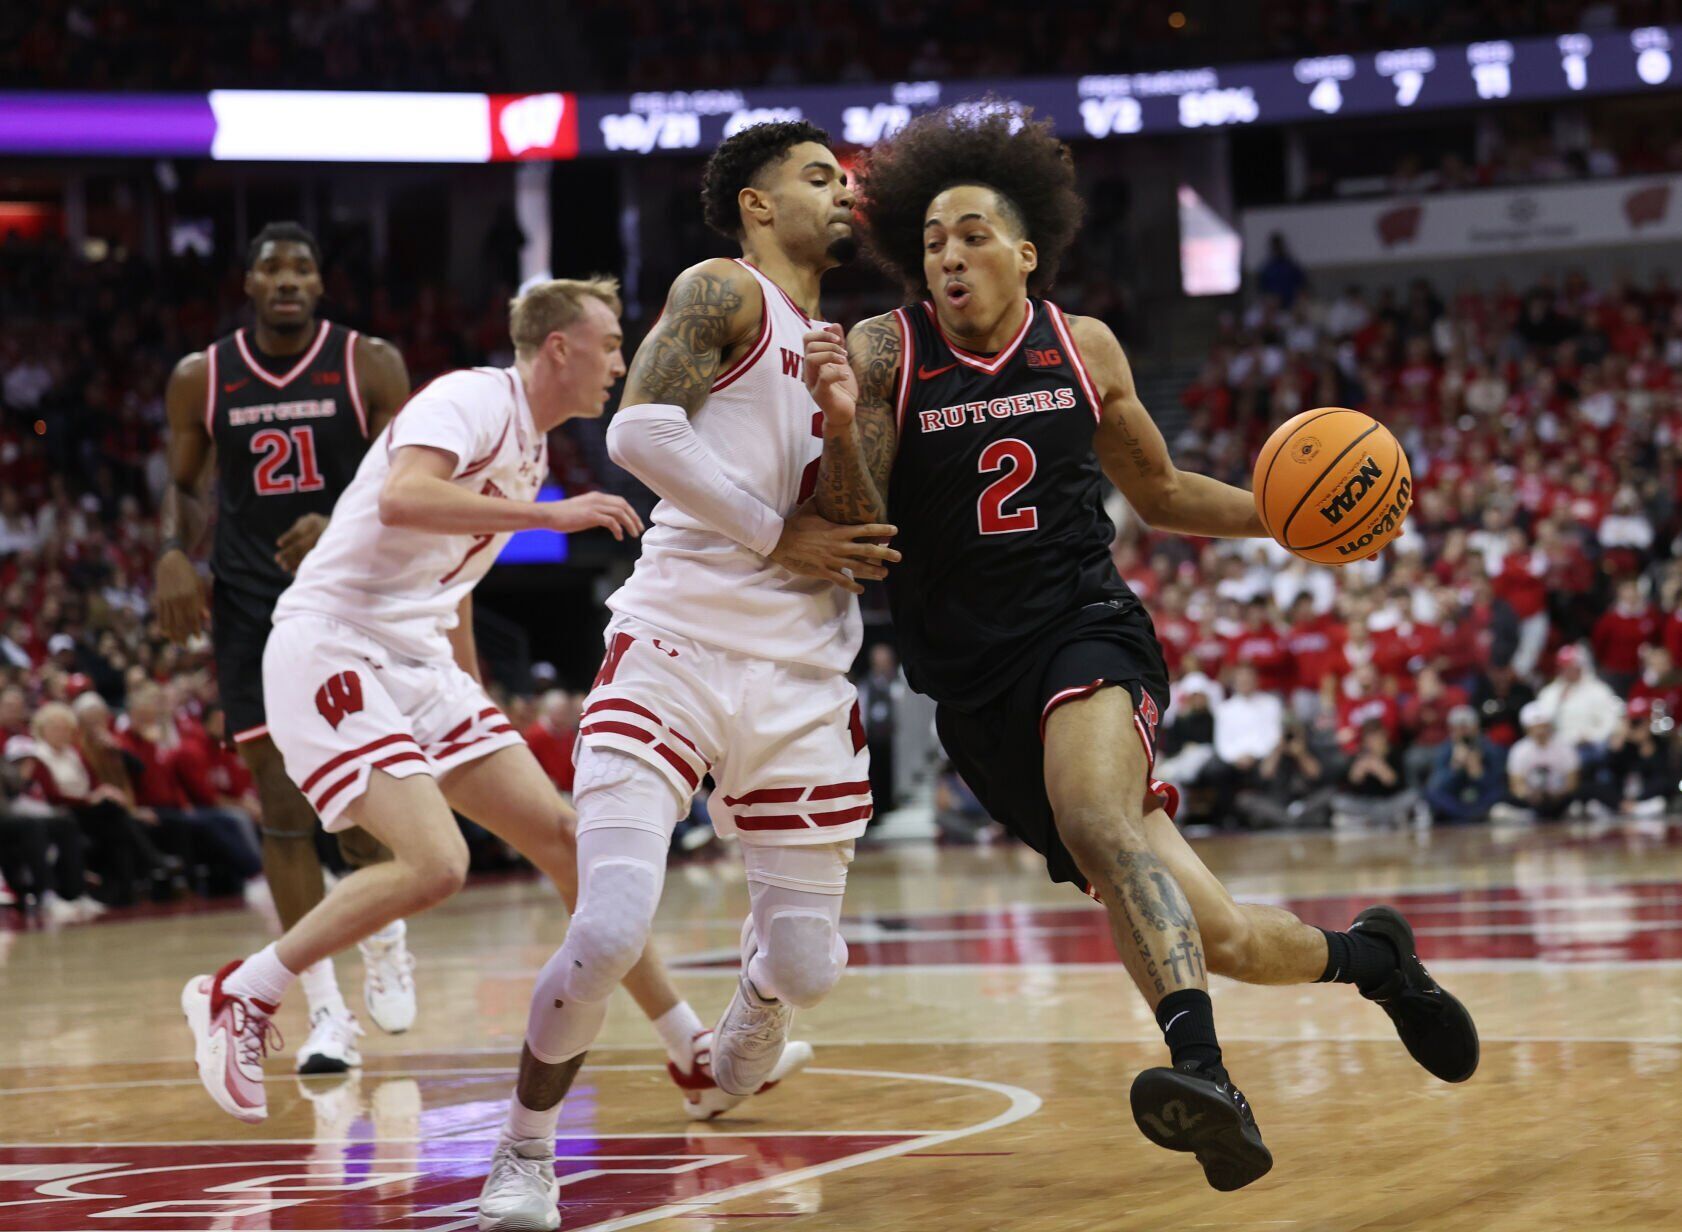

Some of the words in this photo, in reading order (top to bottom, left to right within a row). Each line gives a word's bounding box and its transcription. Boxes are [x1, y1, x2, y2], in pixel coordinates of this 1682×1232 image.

[229, 399, 337, 427] RUTGERS
[919, 387, 1077, 434] RUTGERS
[250, 425, 325, 496] 21
[977, 437, 1039, 536] 2
[1320, 456, 1382, 525] NCAA
[1335, 476, 1411, 556] Wilson
[315, 670, 365, 731] W
[1141, 1098, 1206, 1138] 12
